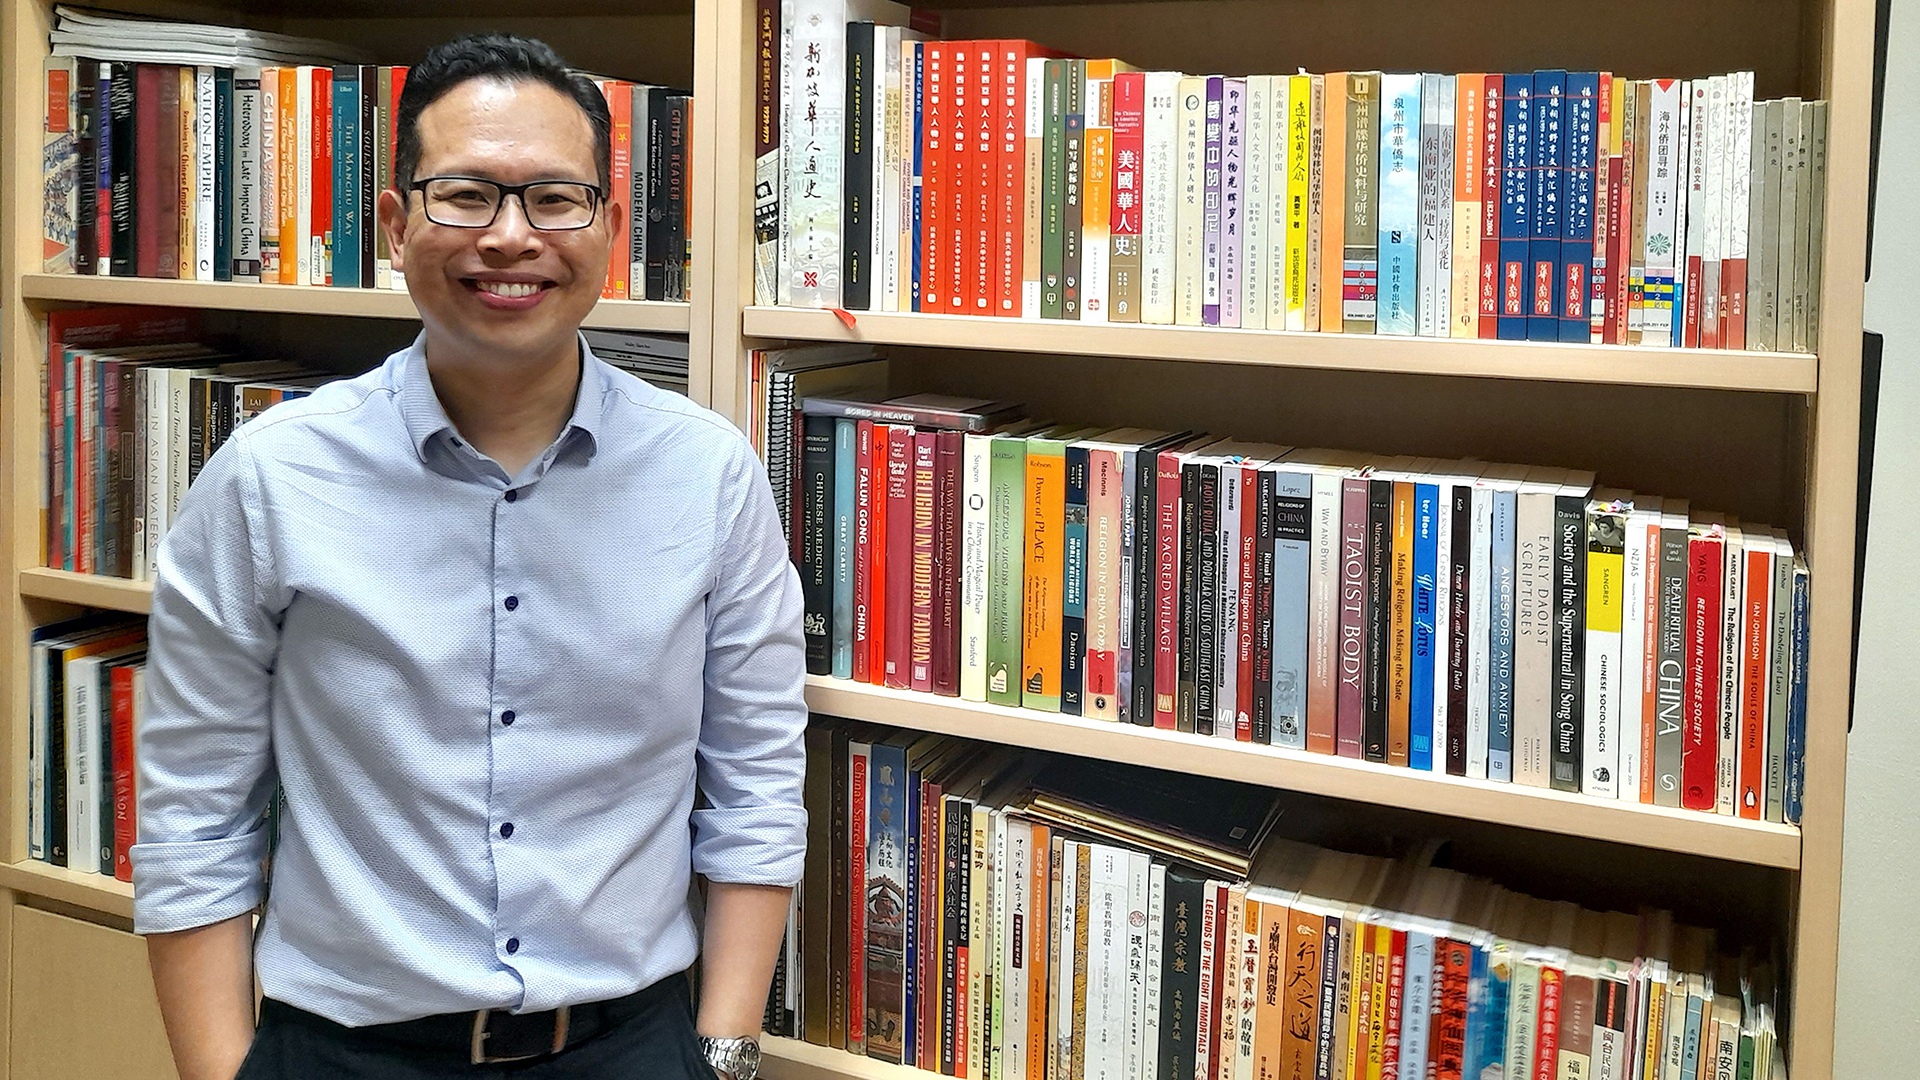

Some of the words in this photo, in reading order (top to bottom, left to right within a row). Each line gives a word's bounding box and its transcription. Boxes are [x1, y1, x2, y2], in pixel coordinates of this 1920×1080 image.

[239, 94, 254, 148] Heterodoxy
[262, 92, 275, 171] CHINA:
[345, 123, 355, 147] THE
[1274, 89, 1285, 173] 东南亚华人与中国
[1392, 97, 1405, 172] 泉州市華僑志
[243, 150, 249, 158] in
[1251, 90, 1261, 195] 东南亚华人文学与文化
[1656, 110, 1671, 179] 海外侨团寻踪
[241, 160, 254, 180] Late
[344, 152, 354, 205] MANCHU
[363, 129, 373, 218] SOULSTEALERS
[1422, 137, 1437, 241] 东南亚的福建人
[239, 183, 254, 225] Imperial
[633, 171, 643, 222] MODERN
[1115, 149, 1135, 256] 美國華人史
[239, 227, 254, 256] China
[344, 210, 354, 237] WAY
[633, 225, 643, 262] CHINA
[1391, 255, 1401, 320] 中國社會出版社
[172, 388, 180, 414] Secret
[150, 415, 158, 431] IN
[170, 416, 180, 447] Trades,
[210, 401, 219, 444] Singapore
[150, 438, 158, 485] ASIAN
[172, 449, 180, 477] Porous
[972, 454, 982, 482] Sangren
[172, 479, 181, 513] Borders
[815, 472, 825, 524] CHINESE
[914, 469, 934, 529] RELIGION
[1033, 476, 1045, 505] Power
[149, 493, 158, 550] WATERS
[839, 515, 848, 543] GREAT
[1034, 507, 1045, 519] of
[1161, 503, 1173, 531] THE
[1277, 512, 1305, 524] CHINA
[815, 526, 825, 586] MEDICINE
[914, 532, 932, 548] IN
[1033, 520, 1046, 564] PLACE
[1243, 536, 1254, 559] State
[1538, 535, 1550, 581] EARLY
[1558, 524, 1578, 563] Society
[839, 546, 847, 583] CLARITY
[913, 551, 933, 608] MODERN
[1161, 536, 1172, 592] SACRED
[1243, 561, 1253, 579] and
[1343, 532, 1364, 618] TAOIST
[1562, 564, 1577, 586] and
[1630, 547, 1639, 577] NZJAS
[1698, 553, 1707, 583] YANG
[1240, 581, 1252, 620] Religion
[1499, 566, 1510, 646] ANCESTORS
[1520, 541, 1534, 637] SCRIPTURES
[1562, 588, 1576, 605] the
[1602, 567, 1610, 606] SANGREN
[1670, 577, 1682, 614] DEATH
[1160, 595, 1172, 654] VILLAGE
[1241, 621, 1252, 631] in
[1536, 588, 1549, 648] DAOIST
[1695, 597, 1705, 644] RELIGION
[1753, 601, 1761, 617] IAN
[912, 611, 931, 664] TAIWAN
[967, 635, 978, 667] Stanford
[1068, 631, 1079, 670] Daoism
[1241, 633, 1252, 662] China
[1557, 608, 1576, 676] Supernatural
[1669, 615, 1681, 653] RITUAL
[1695, 645, 1704, 654] IN
[1751, 618, 1761, 660] JOHNSON
[1342, 624, 1362, 691] BODY
[1498, 649, 1509, 679] AND
[1600, 653, 1608, 691] CHINESE
[1694, 654, 1704, 699] CHINESE
[1560, 678, 1575, 690] in
[1658, 659, 1682, 736] CHINA
[1497, 683, 1508, 738] ANXIETY
[1555, 692, 1574, 719] Song
[1598, 692, 1607, 753] SOCIOLOGICS
[1692, 701, 1703, 746] SOCIETY
[1558, 721, 1574, 754] China
[852, 761, 865, 806] China's
[852, 807, 864, 850] Sacred
[851, 852, 863, 880] Sites
[1203, 899, 1214, 939] LEGENDS
[1202, 954, 1212, 972] THE
[1203, 940, 1213, 953] OF
[1200, 973, 1211, 1000] EIGHT
[1196, 1001, 1209, 1055] IMMORTALS
